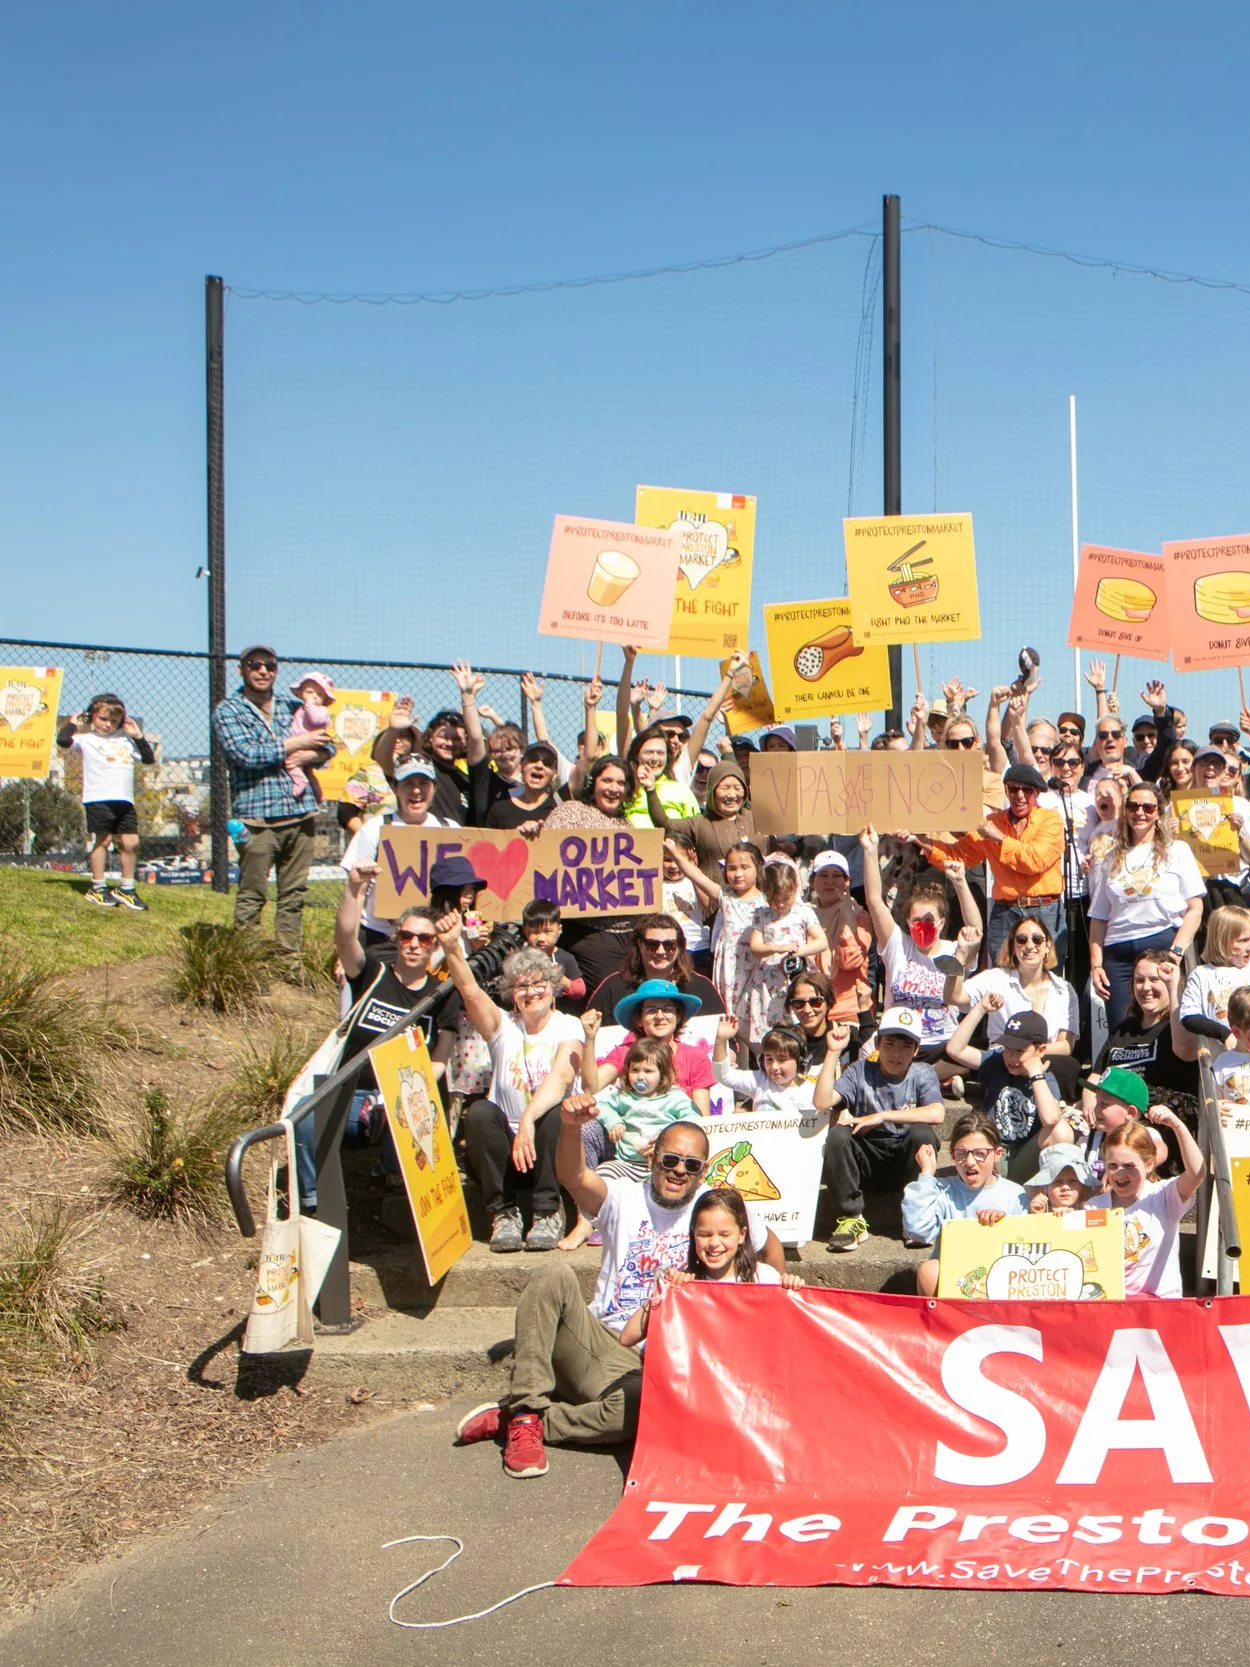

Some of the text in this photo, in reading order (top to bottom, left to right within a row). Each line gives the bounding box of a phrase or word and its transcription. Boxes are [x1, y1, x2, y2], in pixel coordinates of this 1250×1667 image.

[564, 525, 673, 549] #PROTECTPRESTONMARKET
[855, 522, 964, 538] #PROTECTPRESTONMARKET
[679, 554, 718, 567] MARKET
[674, 597, 698, 614] THE
[562, 610, 591, 622] BEFORE
[610, 617, 624, 626] TOO
[627, 619, 649, 630] LATTE
[895, 615, 911, 626] PHO
[915, 615, 928, 624] THE
[930, 612, 961, 623] MARKET
[1098, 628, 1116, 639] DONUT
[1208, 639, 1232, 651] DONUT
[847, 688, 856, 698] BE
[858, 686, 870, 697] ONE
[559, 832, 643, 868] OUR
[533, 867, 659, 912] MARKET
[763, 1211, 788, 1222] HAVE
[1008, 1267, 1069, 1285] PROTECT
[1008, 1282, 1067, 1300] PRESTON
[645, 1501, 842, 1542] The
